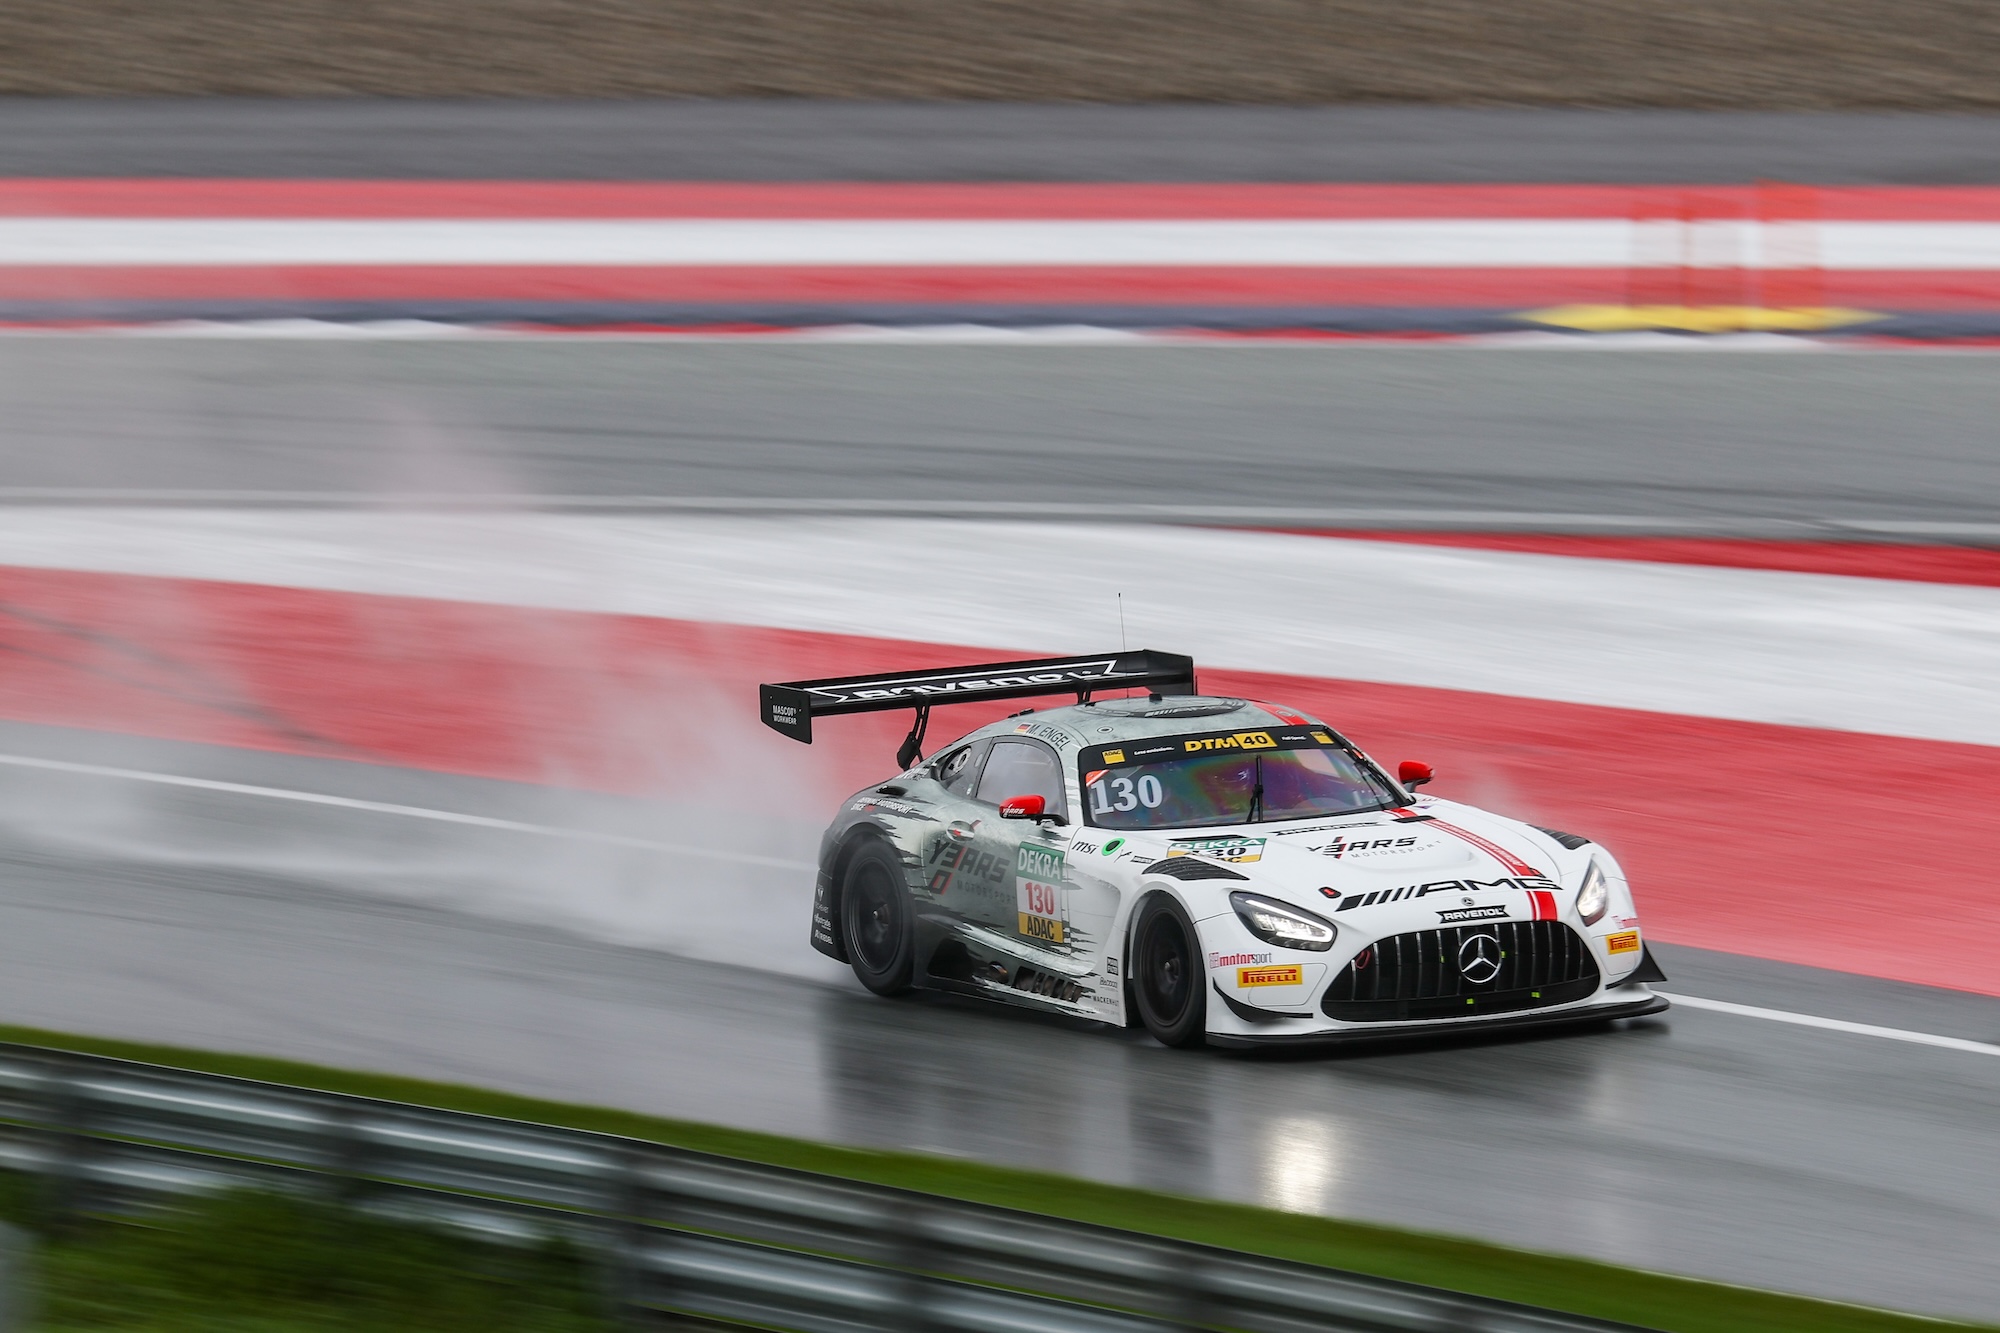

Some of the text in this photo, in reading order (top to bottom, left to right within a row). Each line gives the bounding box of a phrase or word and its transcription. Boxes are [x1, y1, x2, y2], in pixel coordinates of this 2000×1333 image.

[1039, 726, 1071, 752] ENGEL
[1184, 734, 1268, 752] DTM 40
[1091, 774, 1163, 815] 130
[1071, 841, 1099, 854] msi
[1350, 839, 1442, 859] MOTORSPORT
[1017, 847, 1060, 880] DEKRA
[957, 880, 1017, 904] MOTORSPORT
[1025, 881, 1055, 916] 130
[1414, 877, 1564, 899] AMG
[1443, 906, 1505, 920] RAVENOL
[1027, 915, 1055, 940] ADAC
[1242, 969, 1297, 984] PIRELLI
